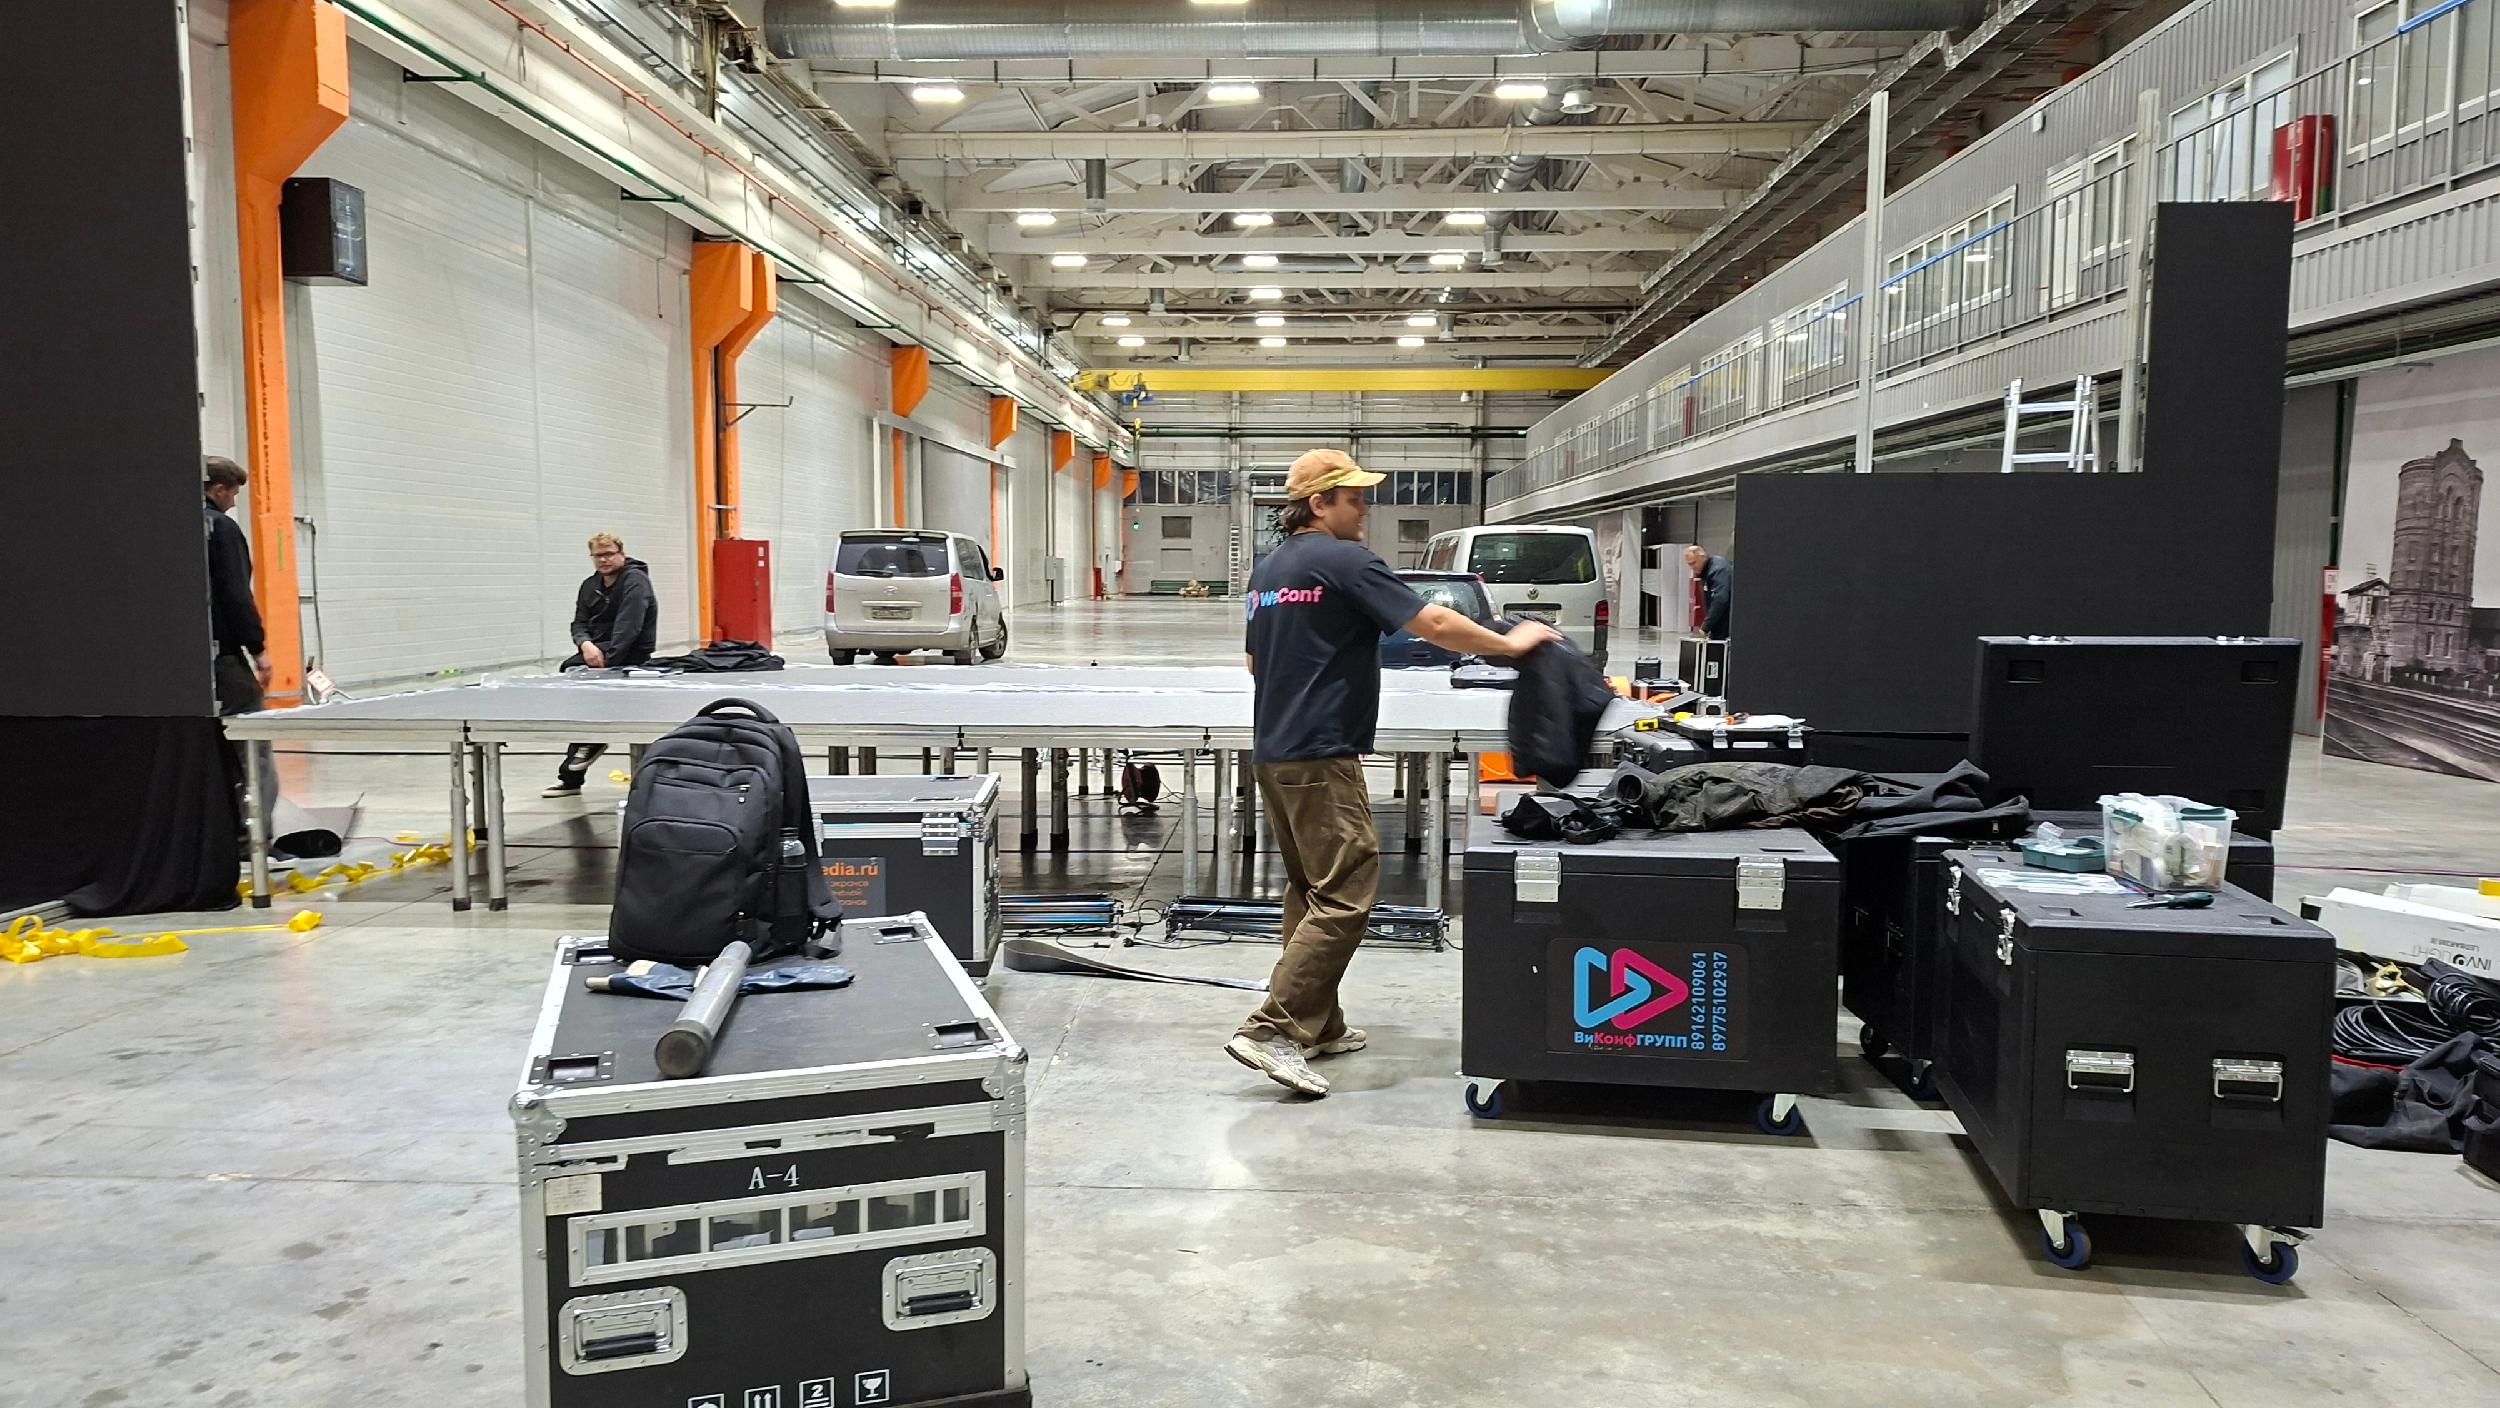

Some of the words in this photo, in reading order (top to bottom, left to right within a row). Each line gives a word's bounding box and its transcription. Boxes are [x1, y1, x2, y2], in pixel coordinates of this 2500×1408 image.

[1691, 951, 1706, 1050] 89162109061
[1712, 951, 1728, 1051] 89775102937
[1574, 1031, 1688, 1048] ВиКонфГРУПП
[748, 1164, 800, 1190] A-4
